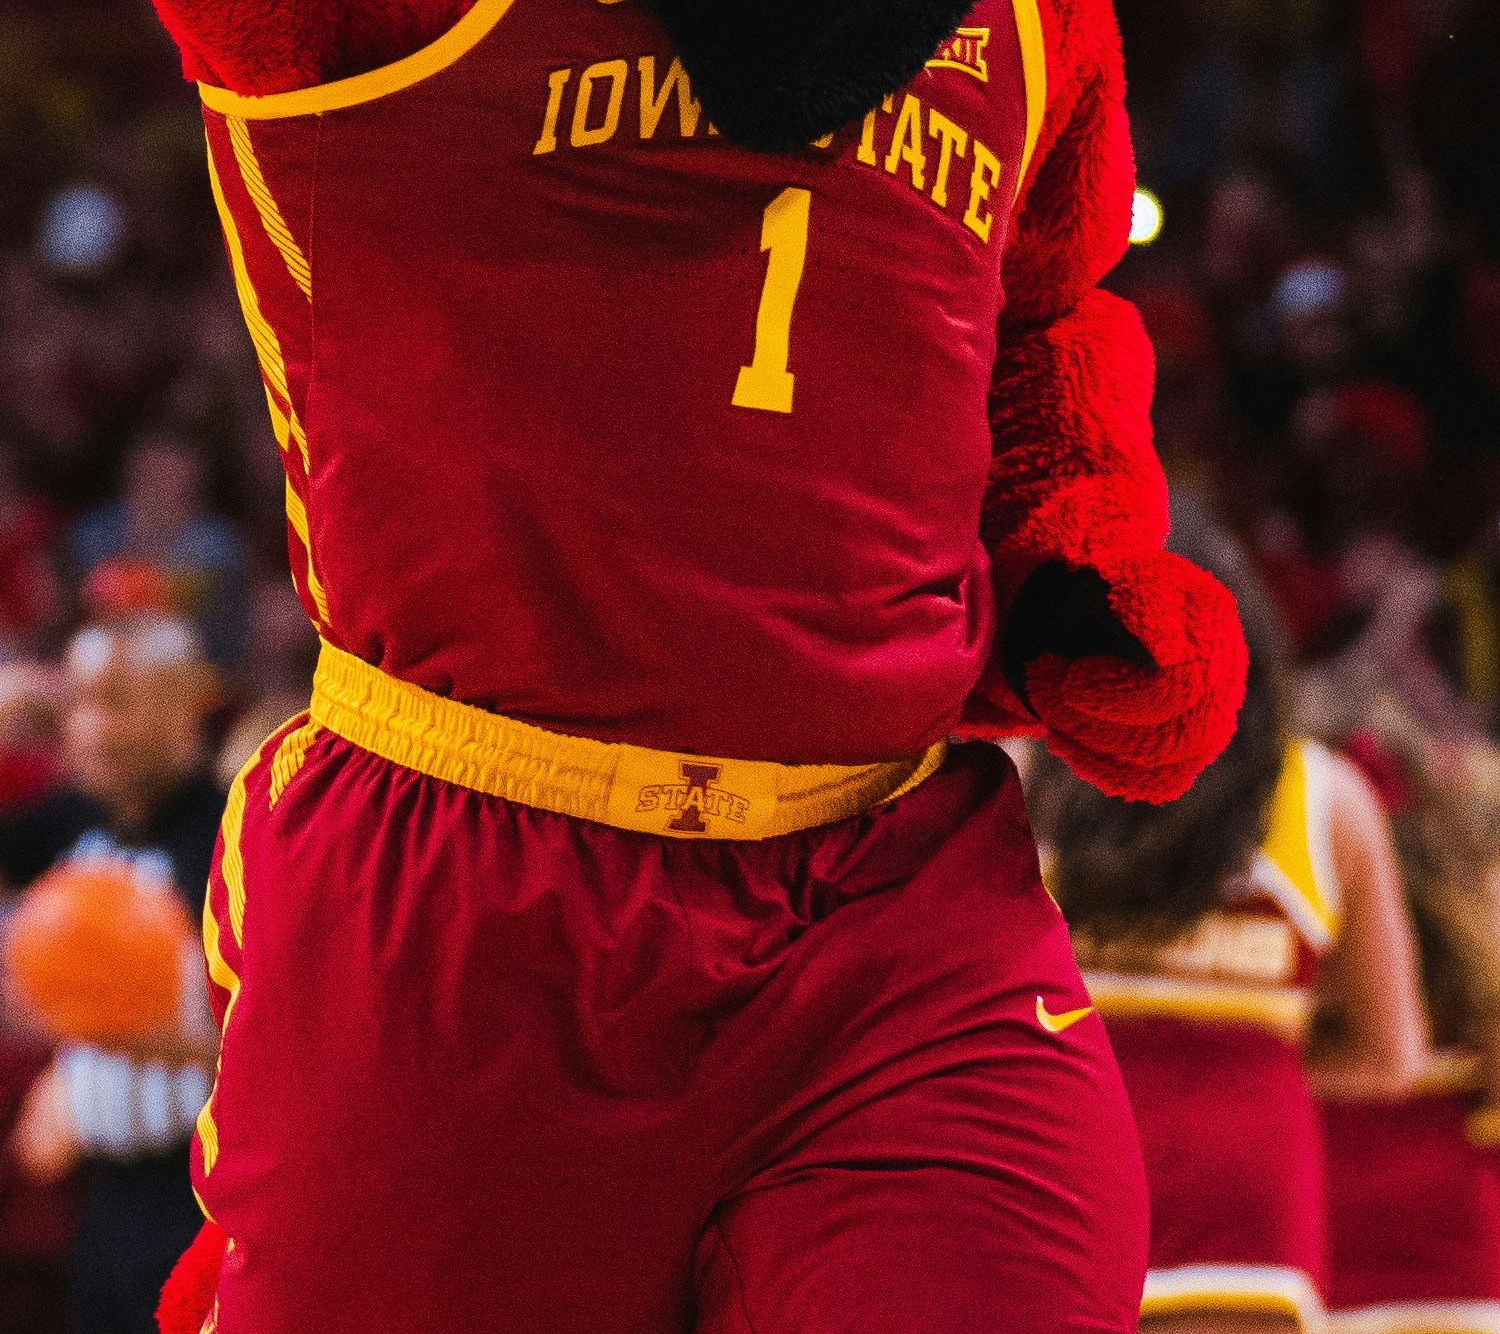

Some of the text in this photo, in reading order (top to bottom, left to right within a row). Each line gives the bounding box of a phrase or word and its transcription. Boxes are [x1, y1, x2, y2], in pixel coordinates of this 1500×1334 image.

[533, 55, 1001, 244] IOW TATE
[731, 186, 811, 413] 1
[634, 783, 750, 824] STATE
